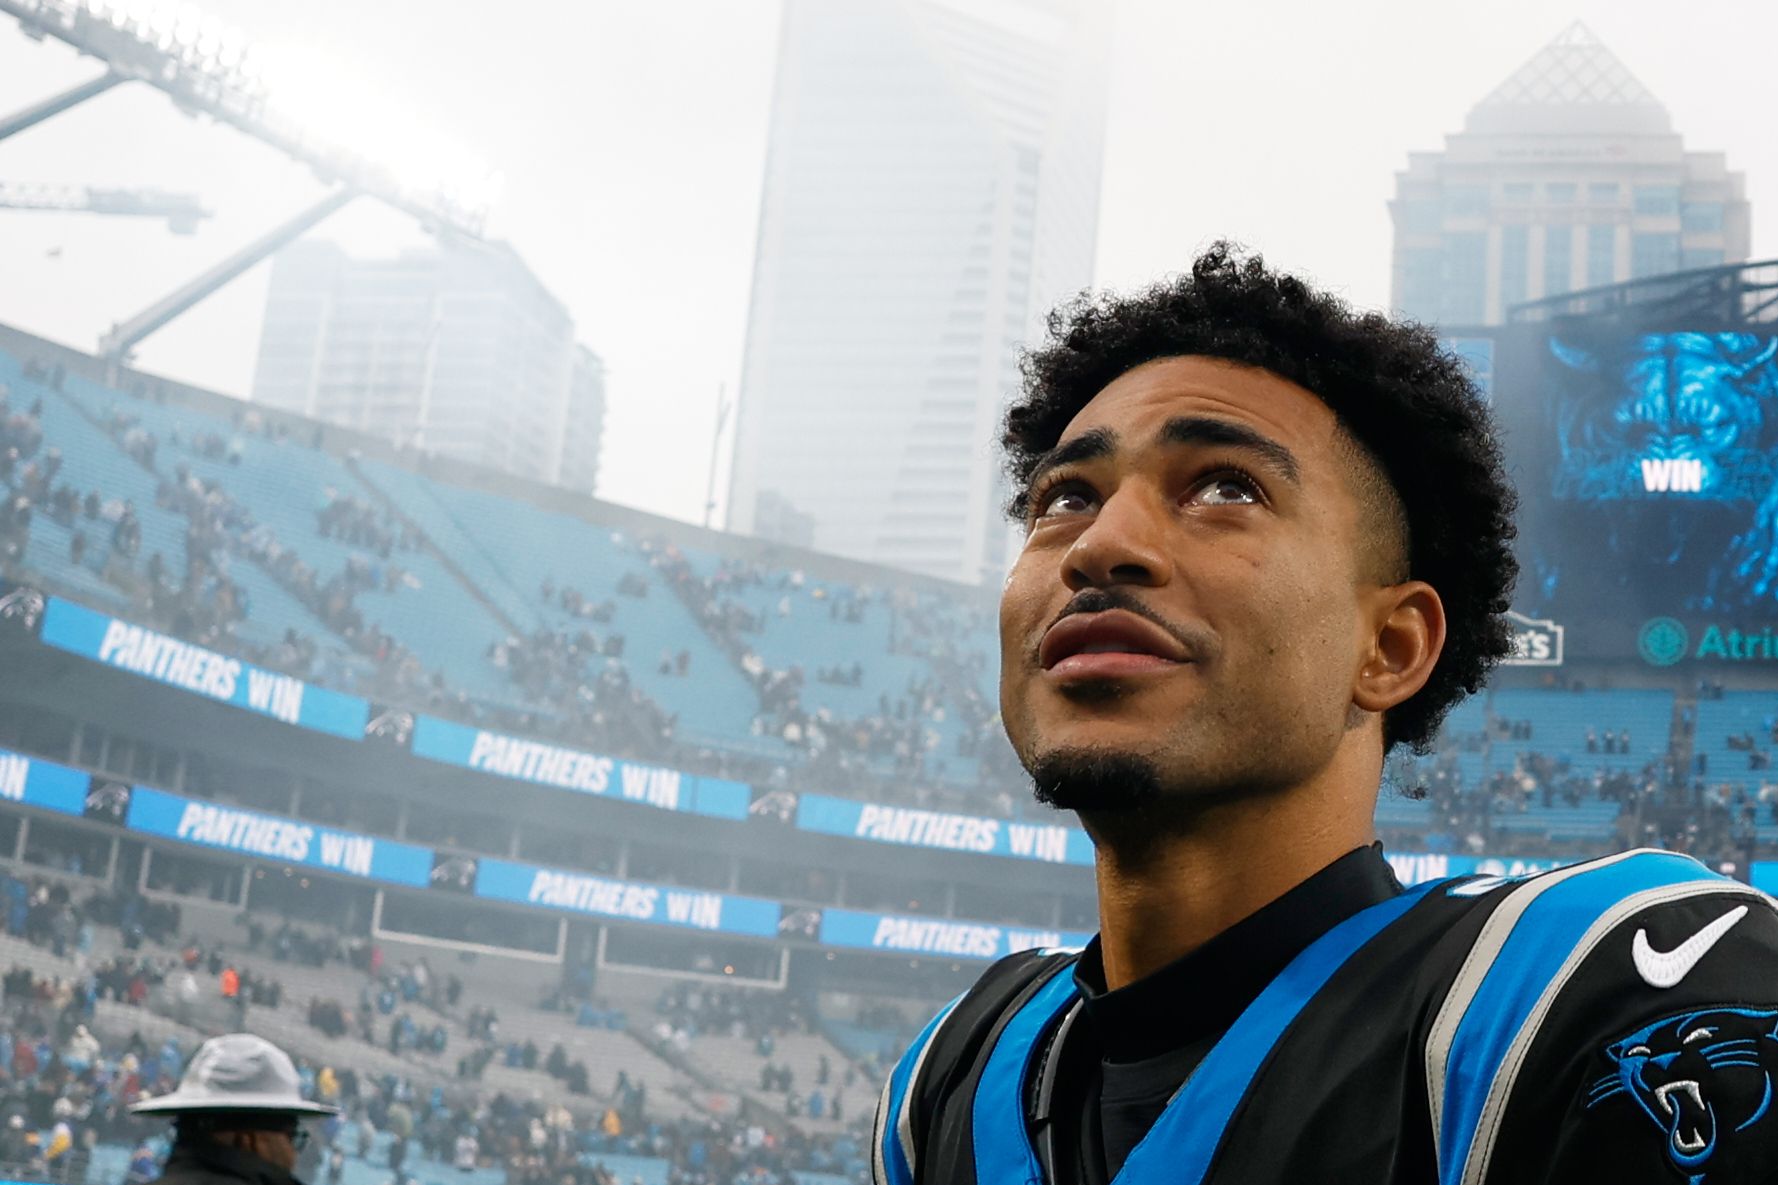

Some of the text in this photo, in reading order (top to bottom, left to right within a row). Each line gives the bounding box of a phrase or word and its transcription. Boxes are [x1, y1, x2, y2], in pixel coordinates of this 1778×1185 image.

[1642, 460, 1701, 491] WIN
[99, 619, 304, 724] PANTHERS WIN
[469, 731, 681, 810] PANTHERS WIN
[177, 802, 374, 876] PANTHERS WIN
[856, 803, 1068, 863] PANTHERS WIN
[528, 870, 722, 929] PANTHERS WIN
[873, 916, 1000, 957] PANTHERS
